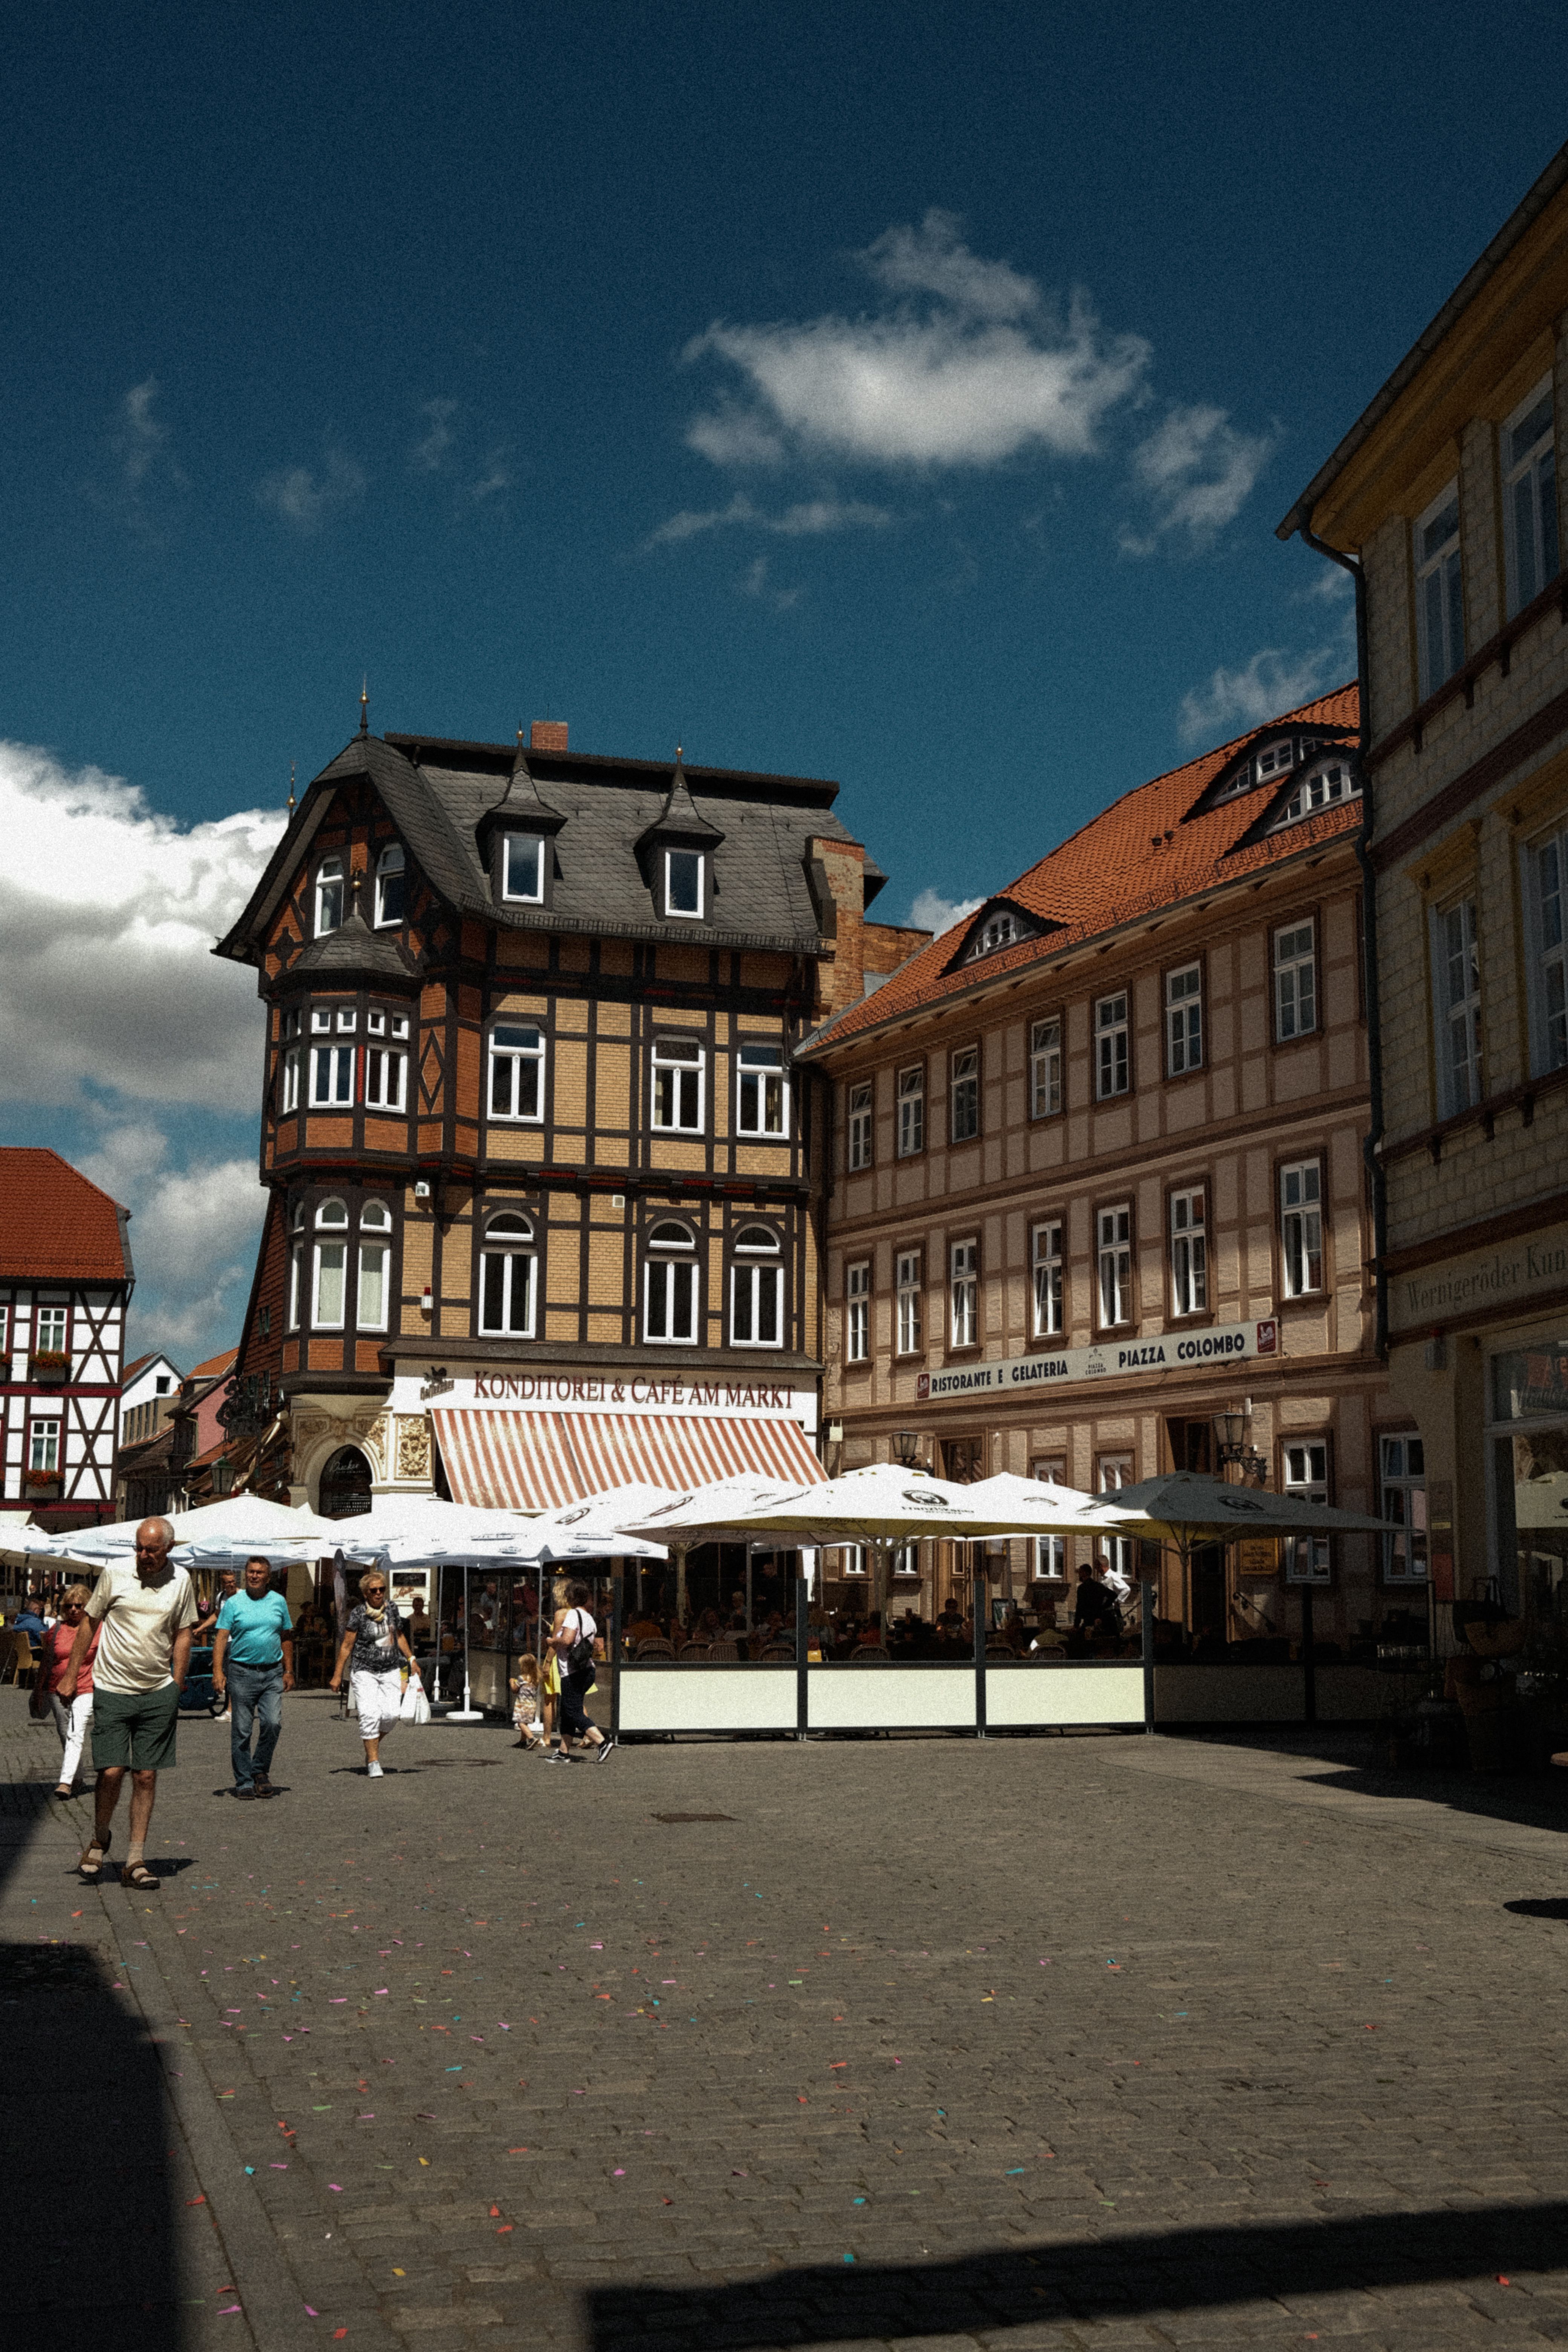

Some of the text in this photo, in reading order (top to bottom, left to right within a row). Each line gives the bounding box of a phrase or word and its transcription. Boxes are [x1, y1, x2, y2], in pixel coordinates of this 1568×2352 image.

[1406, 1243, 1568, 1313] Wernigeröder Kun
[1119, 1346, 1165, 1368] PIAZZA
[1178, 1333, 1245, 1360] COLOMBO
[474, 1370, 606, 1402] KONDITOREI
[611, 1378, 626, 1403] &
[631, 1375, 684, 1405] CAFÉ
[689, 1381, 721, 1406] AM
[725, 1382, 796, 1409] MARKT
[931, 1370, 991, 1393] RISTORANTE
[998, 1369, 1003, 1384] E
[1012, 1360, 1068, 1382] GELATERIA
